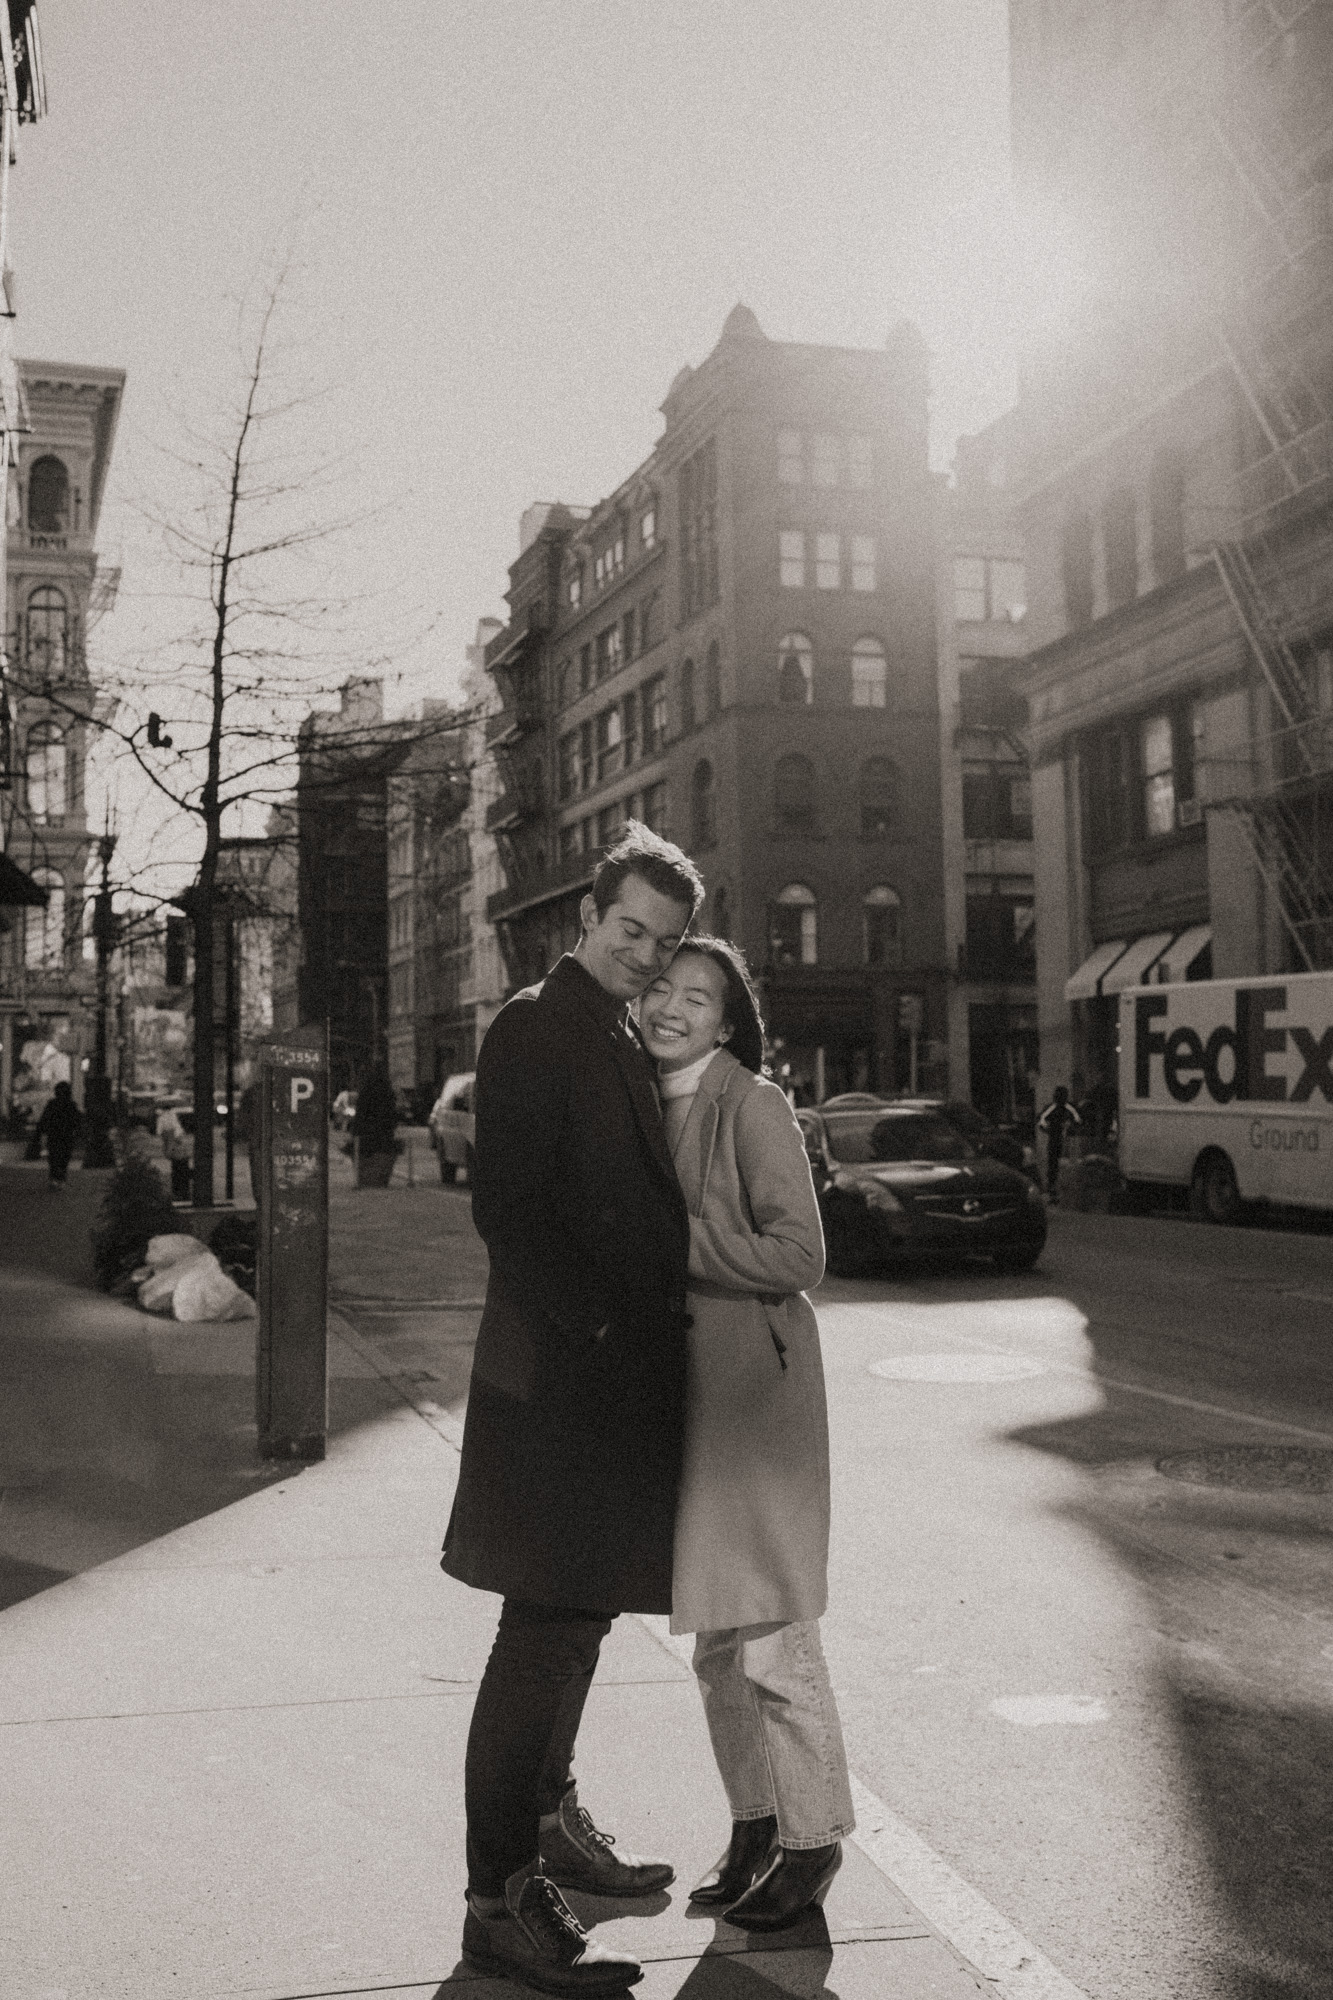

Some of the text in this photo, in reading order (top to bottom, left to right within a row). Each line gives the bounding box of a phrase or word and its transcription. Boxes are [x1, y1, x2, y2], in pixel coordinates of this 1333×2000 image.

[1136, 986, 1333, 1105] FedEx
[291, 1077, 314, 1113] P
[1250, 1121, 1319, 1151] Ground
